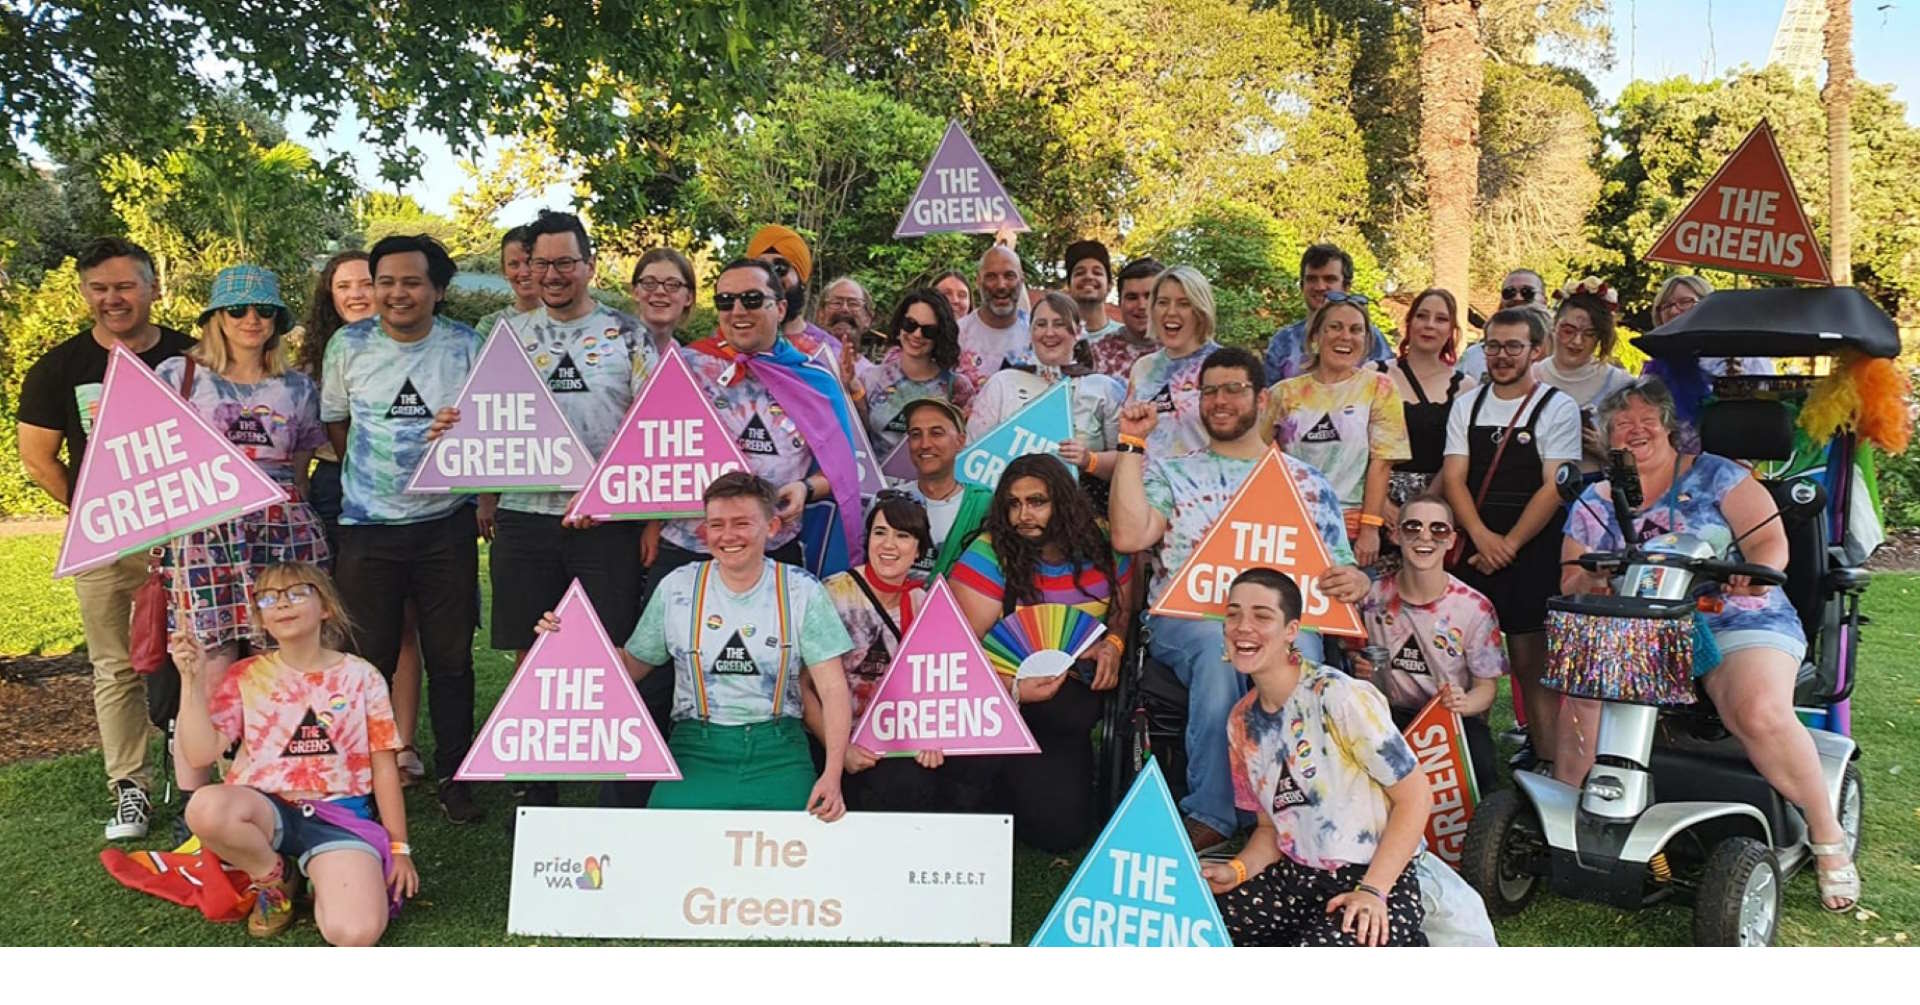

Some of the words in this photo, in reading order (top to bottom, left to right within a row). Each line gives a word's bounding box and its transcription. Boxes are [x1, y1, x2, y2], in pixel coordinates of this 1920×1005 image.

[936, 167, 981, 194] THE
[913, 196, 1006, 226] GREENS
[1719, 186, 1780, 226] THE
[1675, 221, 1806, 268] GREENS
[559, 367, 575, 377] THE
[401, 394, 417, 405] THE
[472, 393, 537, 431] THE
[104, 418, 188, 481] THE
[637, 419, 705, 458] THE
[749, 428, 766, 439] THE
[436, 437, 573, 477] GREENS
[79, 454, 240, 543] GREENS
[1230, 521, 1299, 566] THE
[715, 660, 754, 673] GREENS
[726, 647, 745, 660] THE
[907, 652, 968, 693] THE
[534, 668, 605, 710] THE
[301, 725, 320, 738] THE
[871, 696, 1003, 741] GREENS
[289, 739, 330, 753] GREENS
[492, 717, 642, 762] GREENS
[533, 857, 582, 877] pride
[725, 830, 808, 868] The
[545, 876, 573, 888] WA
[908, 870, 986, 885] R.E.S.P.E.C.T
[1109, 849, 1178, 906] THE
[682, 886, 843, 927] Greens
